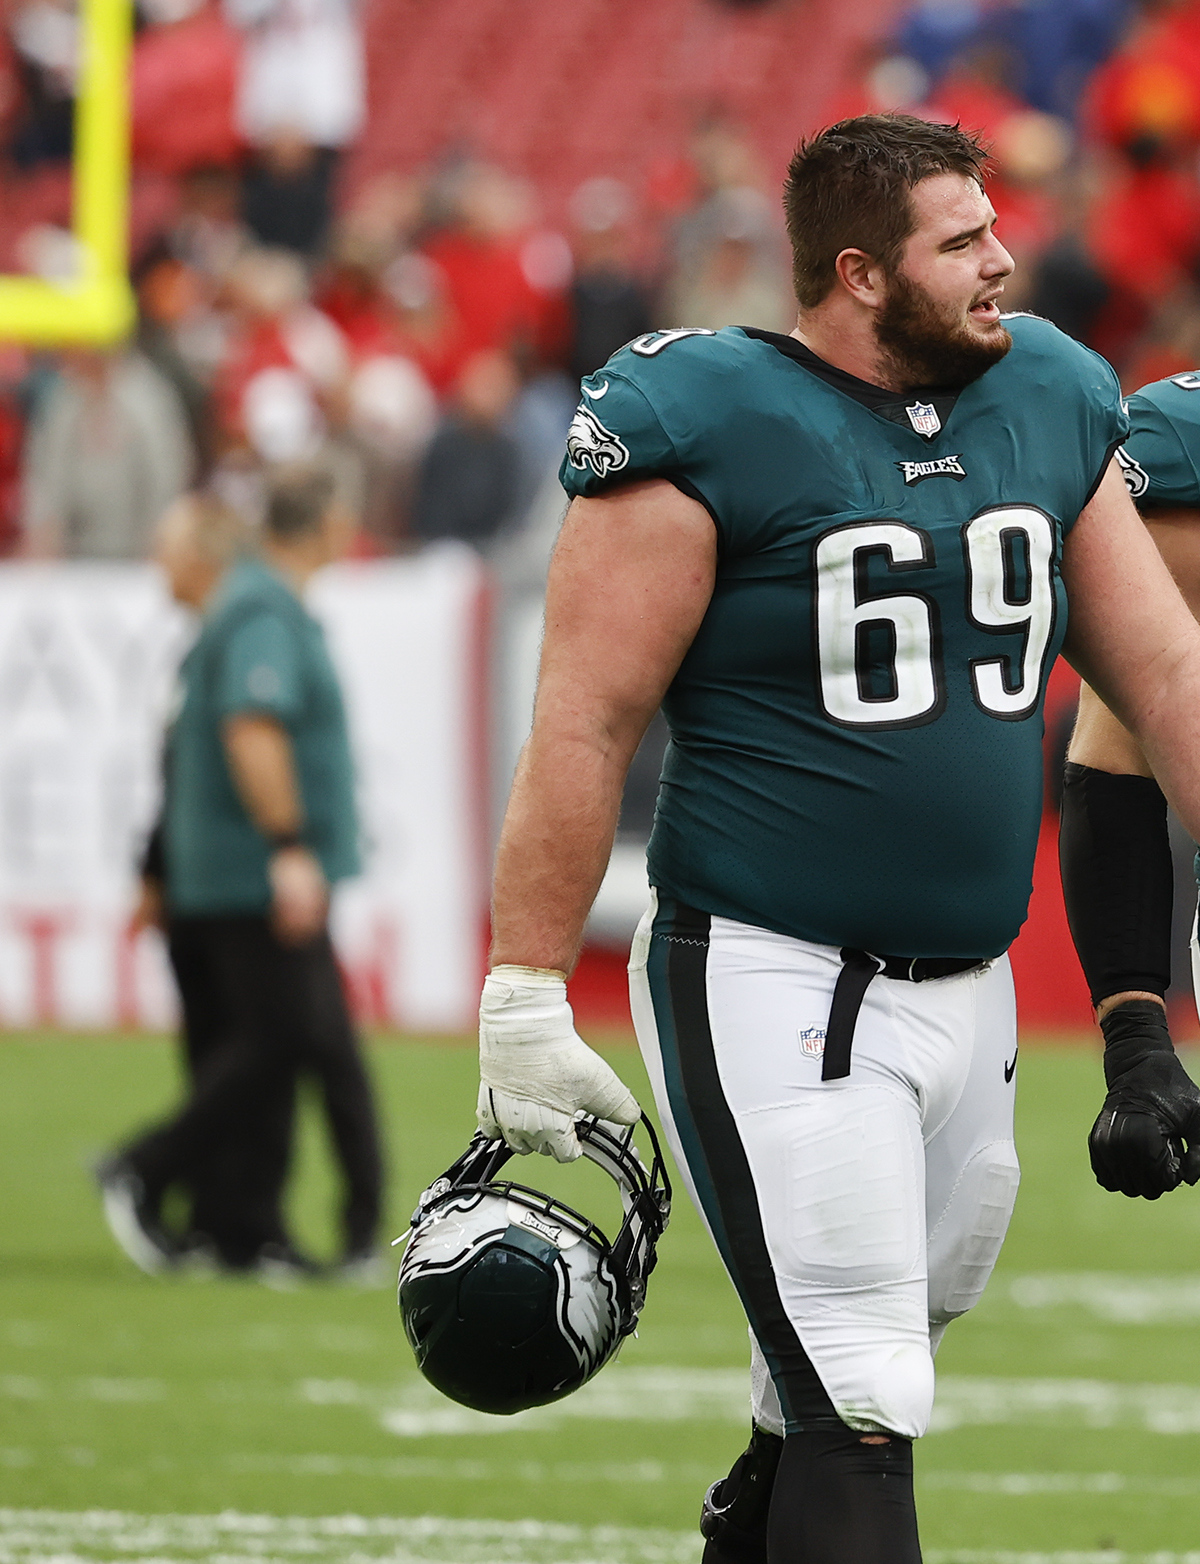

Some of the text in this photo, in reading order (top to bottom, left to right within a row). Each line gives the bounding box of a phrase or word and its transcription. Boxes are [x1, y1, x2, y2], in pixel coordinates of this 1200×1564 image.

[915, 416, 937, 431] NFL
[896, 453, 968, 485] EAGLES
[812, 504, 1060, 731] 69
